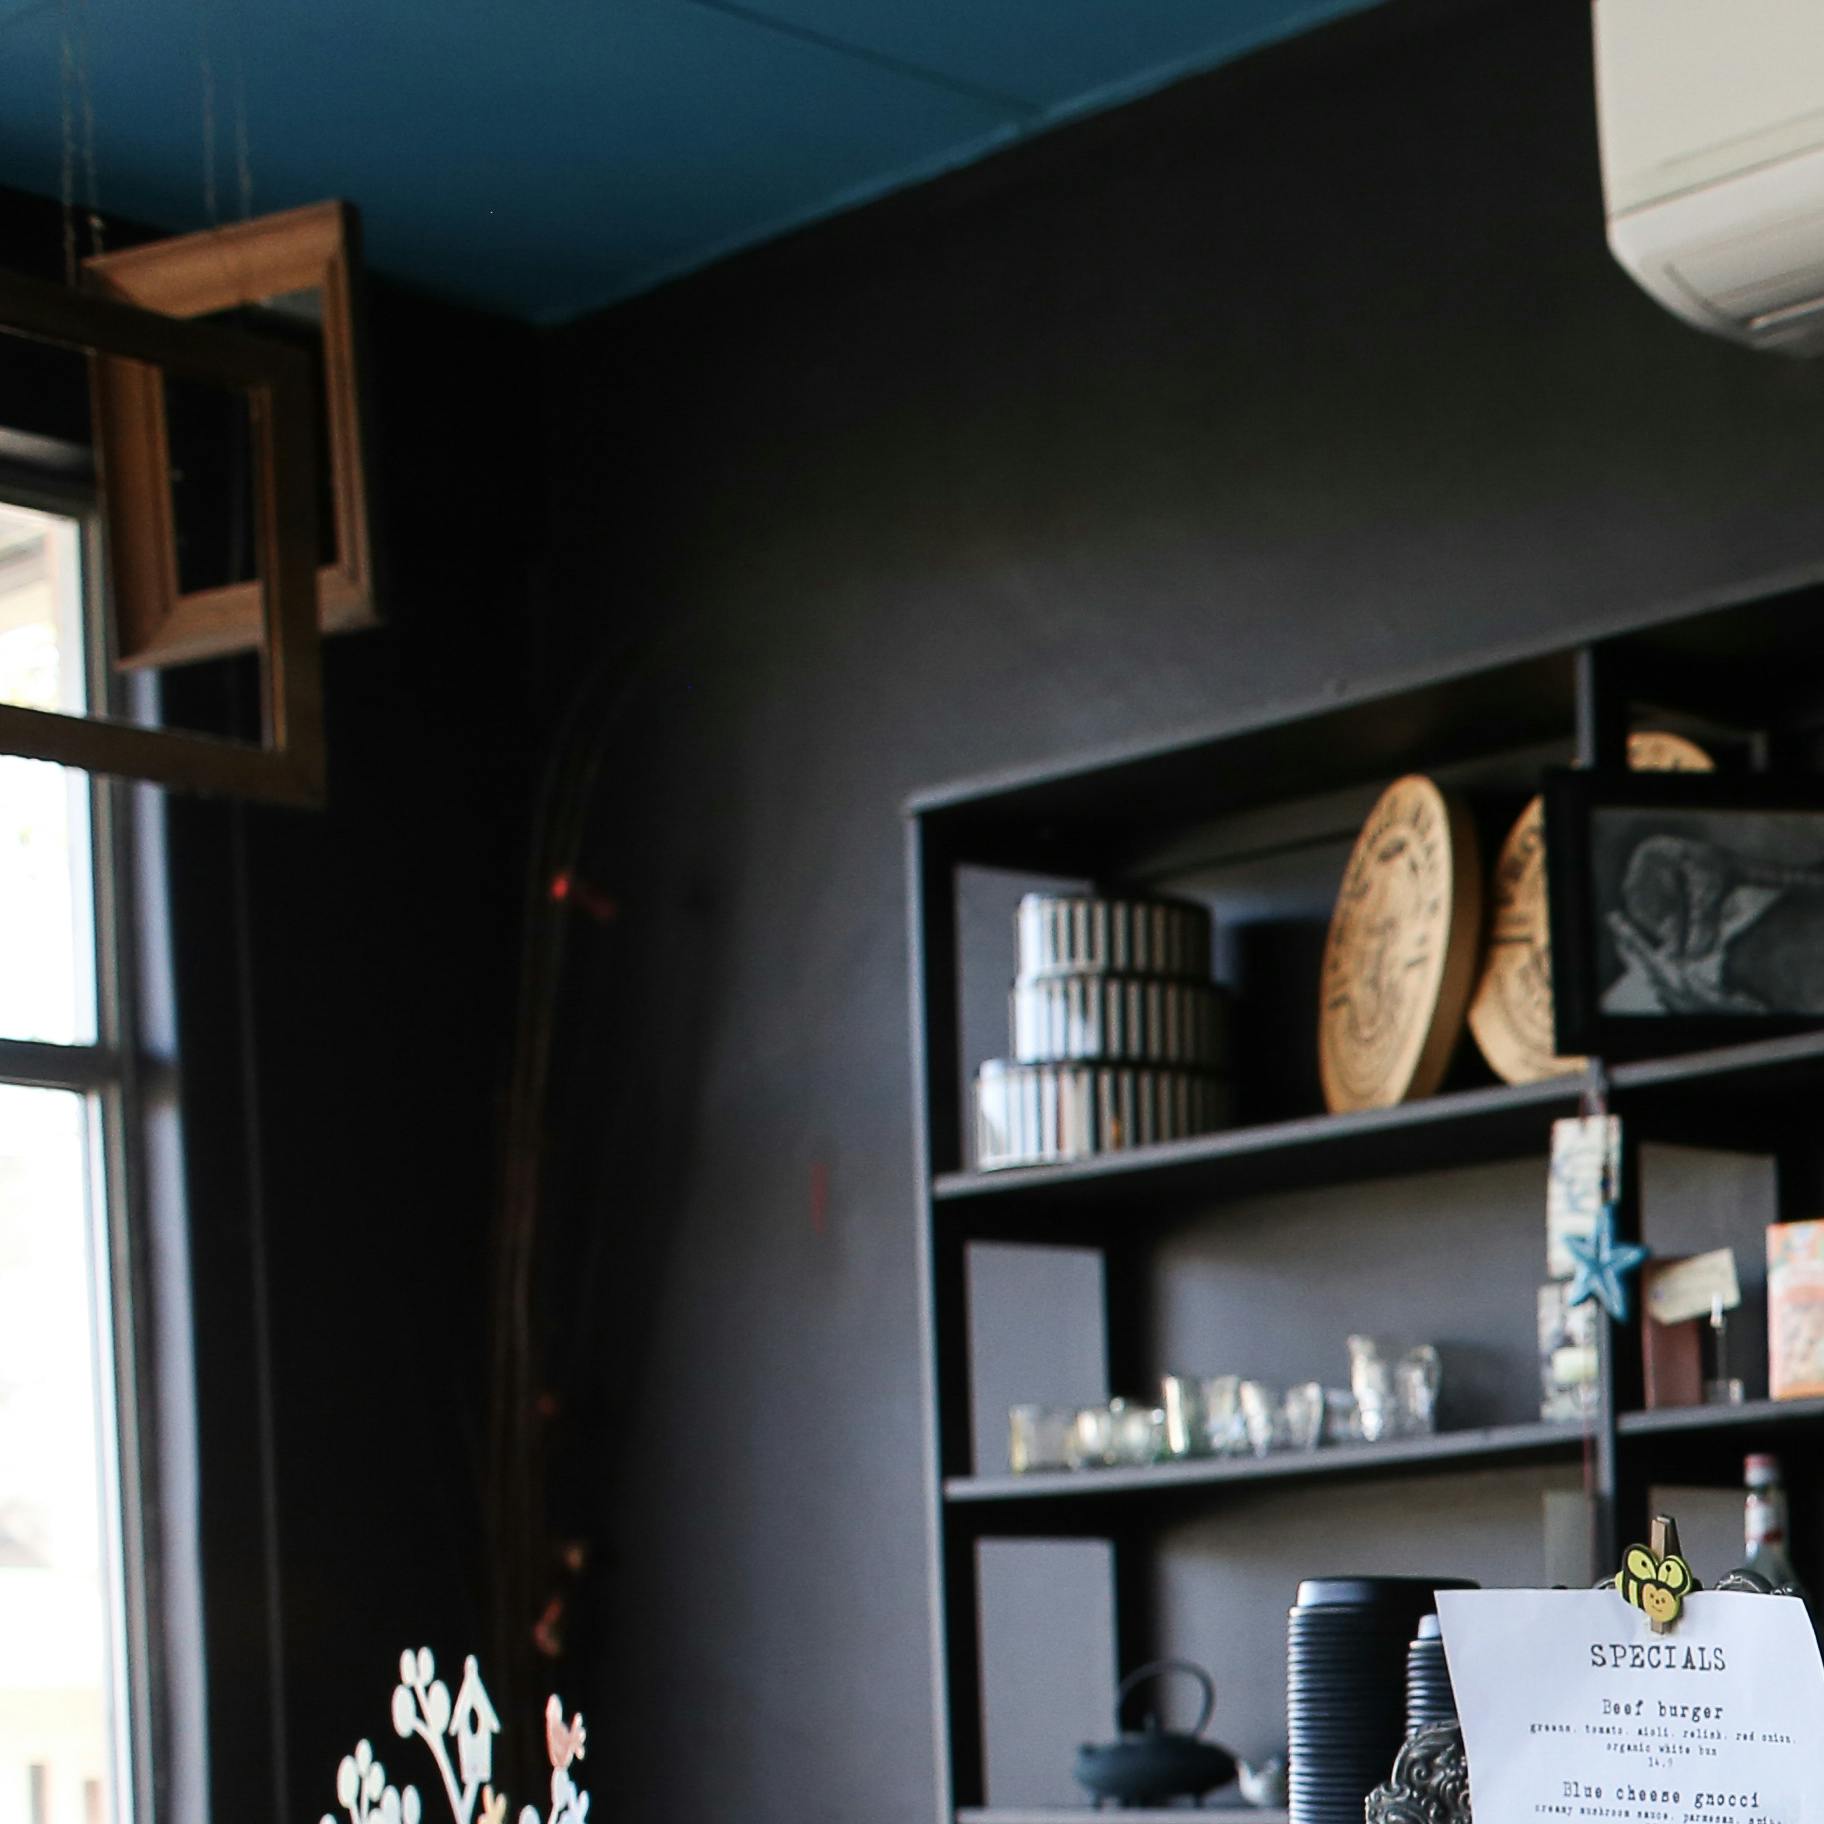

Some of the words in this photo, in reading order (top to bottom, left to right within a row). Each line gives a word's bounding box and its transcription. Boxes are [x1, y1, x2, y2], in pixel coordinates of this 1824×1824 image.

[1590, 1644, 1727, 1671] SPECIALS
[1602, 1699, 1643, 1716] Beef
[1658, 1701, 1723, 1722] burger
[1606, 1741, 1651, 1754] organic
[1658, 1742, 1690, 1755] white
[1562, 1781, 1603, 1799] Blue
[1616, 1784, 1680, 1804] cheese
[1694, 1791, 1760, 1809] gnocci
[1535, 1803, 1573, 1816] creamy
[1579, 1805, 1630, 1818] mushroom
